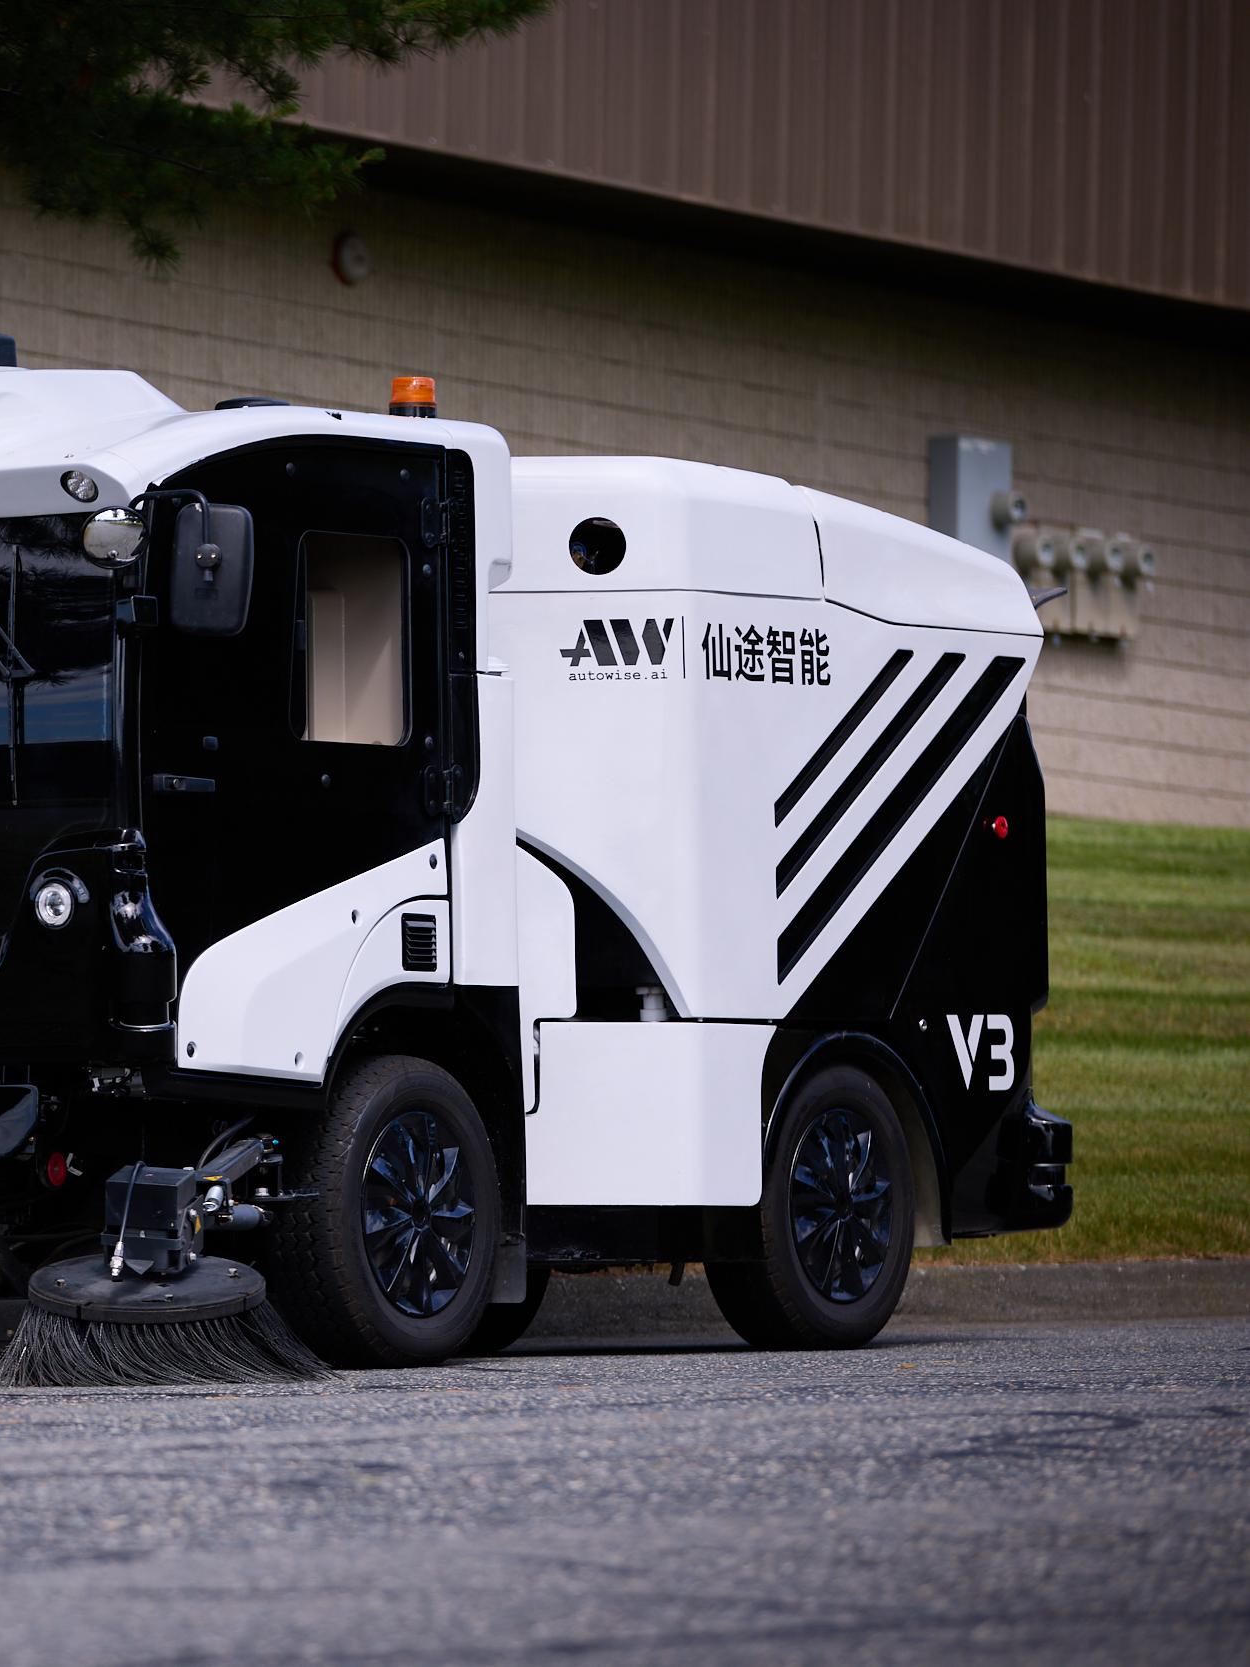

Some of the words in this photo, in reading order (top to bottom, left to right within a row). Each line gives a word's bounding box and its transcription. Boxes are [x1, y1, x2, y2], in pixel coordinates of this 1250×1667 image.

[559, 618, 675, 667] AW
[701, 622, 831, 686] 仙途智能
[568, 669, 668, 681] autowise.ai
[946, 1014, 1016, 1091] V3
